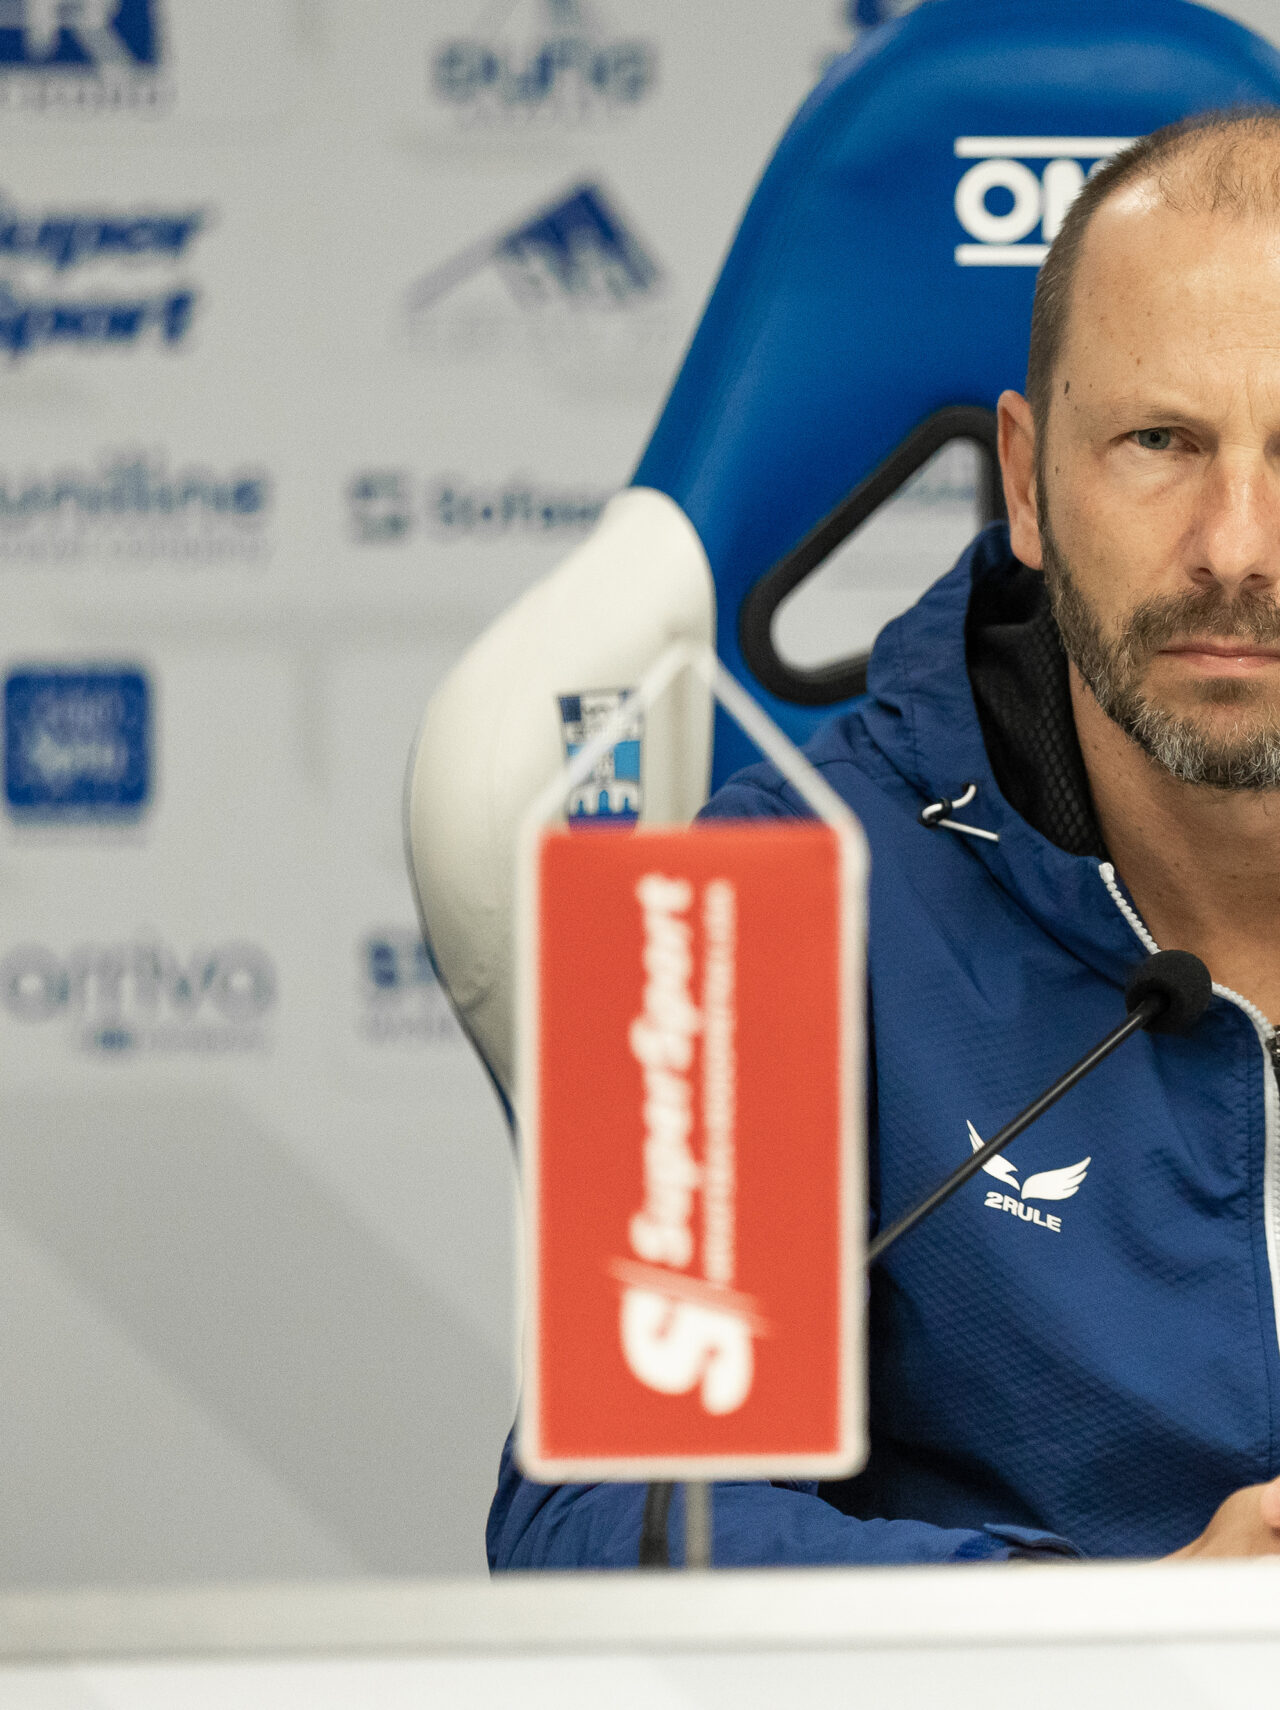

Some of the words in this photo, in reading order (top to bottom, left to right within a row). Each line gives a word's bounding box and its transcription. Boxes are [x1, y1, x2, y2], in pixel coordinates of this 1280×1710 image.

[0, 208, 206, 272] uper
[630, 874, 704, 1268] SuperSport
[983, 1191, 1062, 1233] 2RULE
